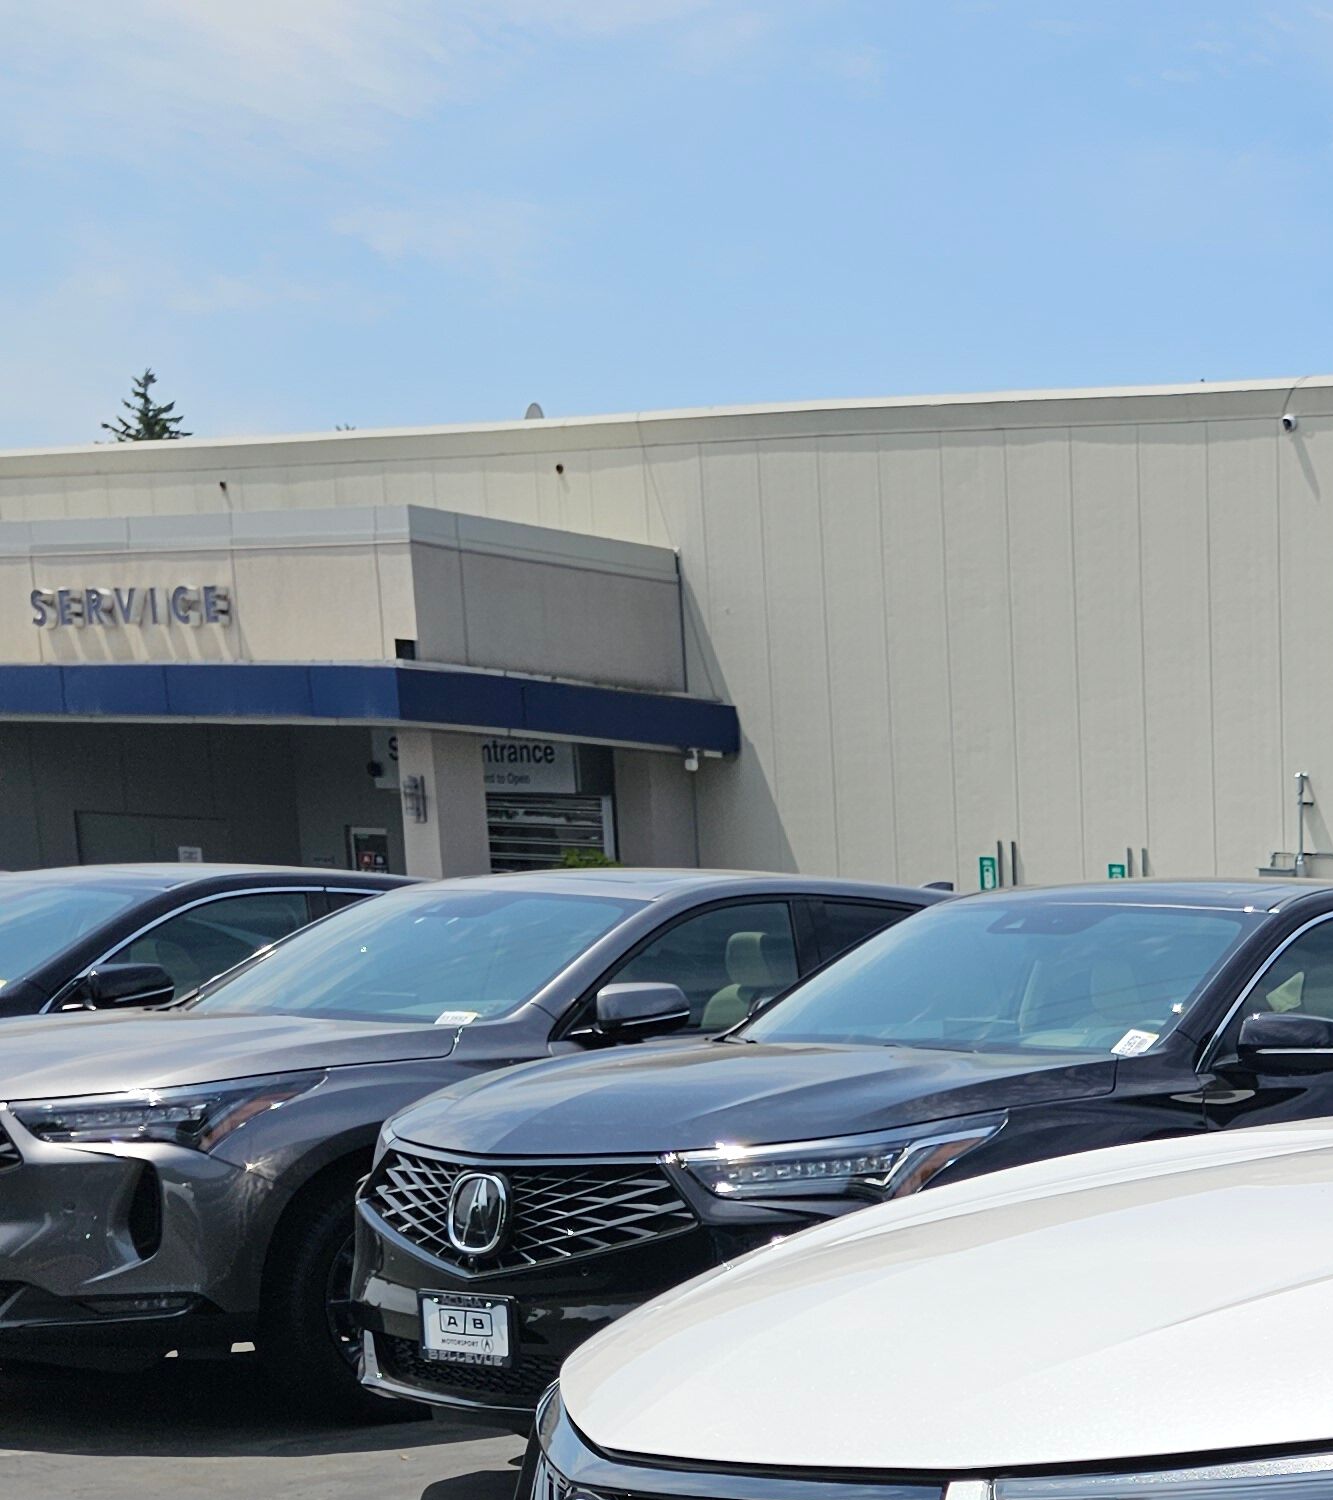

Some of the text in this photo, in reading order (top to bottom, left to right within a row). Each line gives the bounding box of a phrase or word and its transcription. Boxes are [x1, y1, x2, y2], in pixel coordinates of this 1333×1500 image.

[30, 584, 224, 628] SERVICE
[481, 740, 556, 765] ntrance
[447, 1315, 485, 1330] A B
[441, 1338, 479, 1347] MOTORSPORT
[428, 1348, 504, 1367] BELLEVUE
